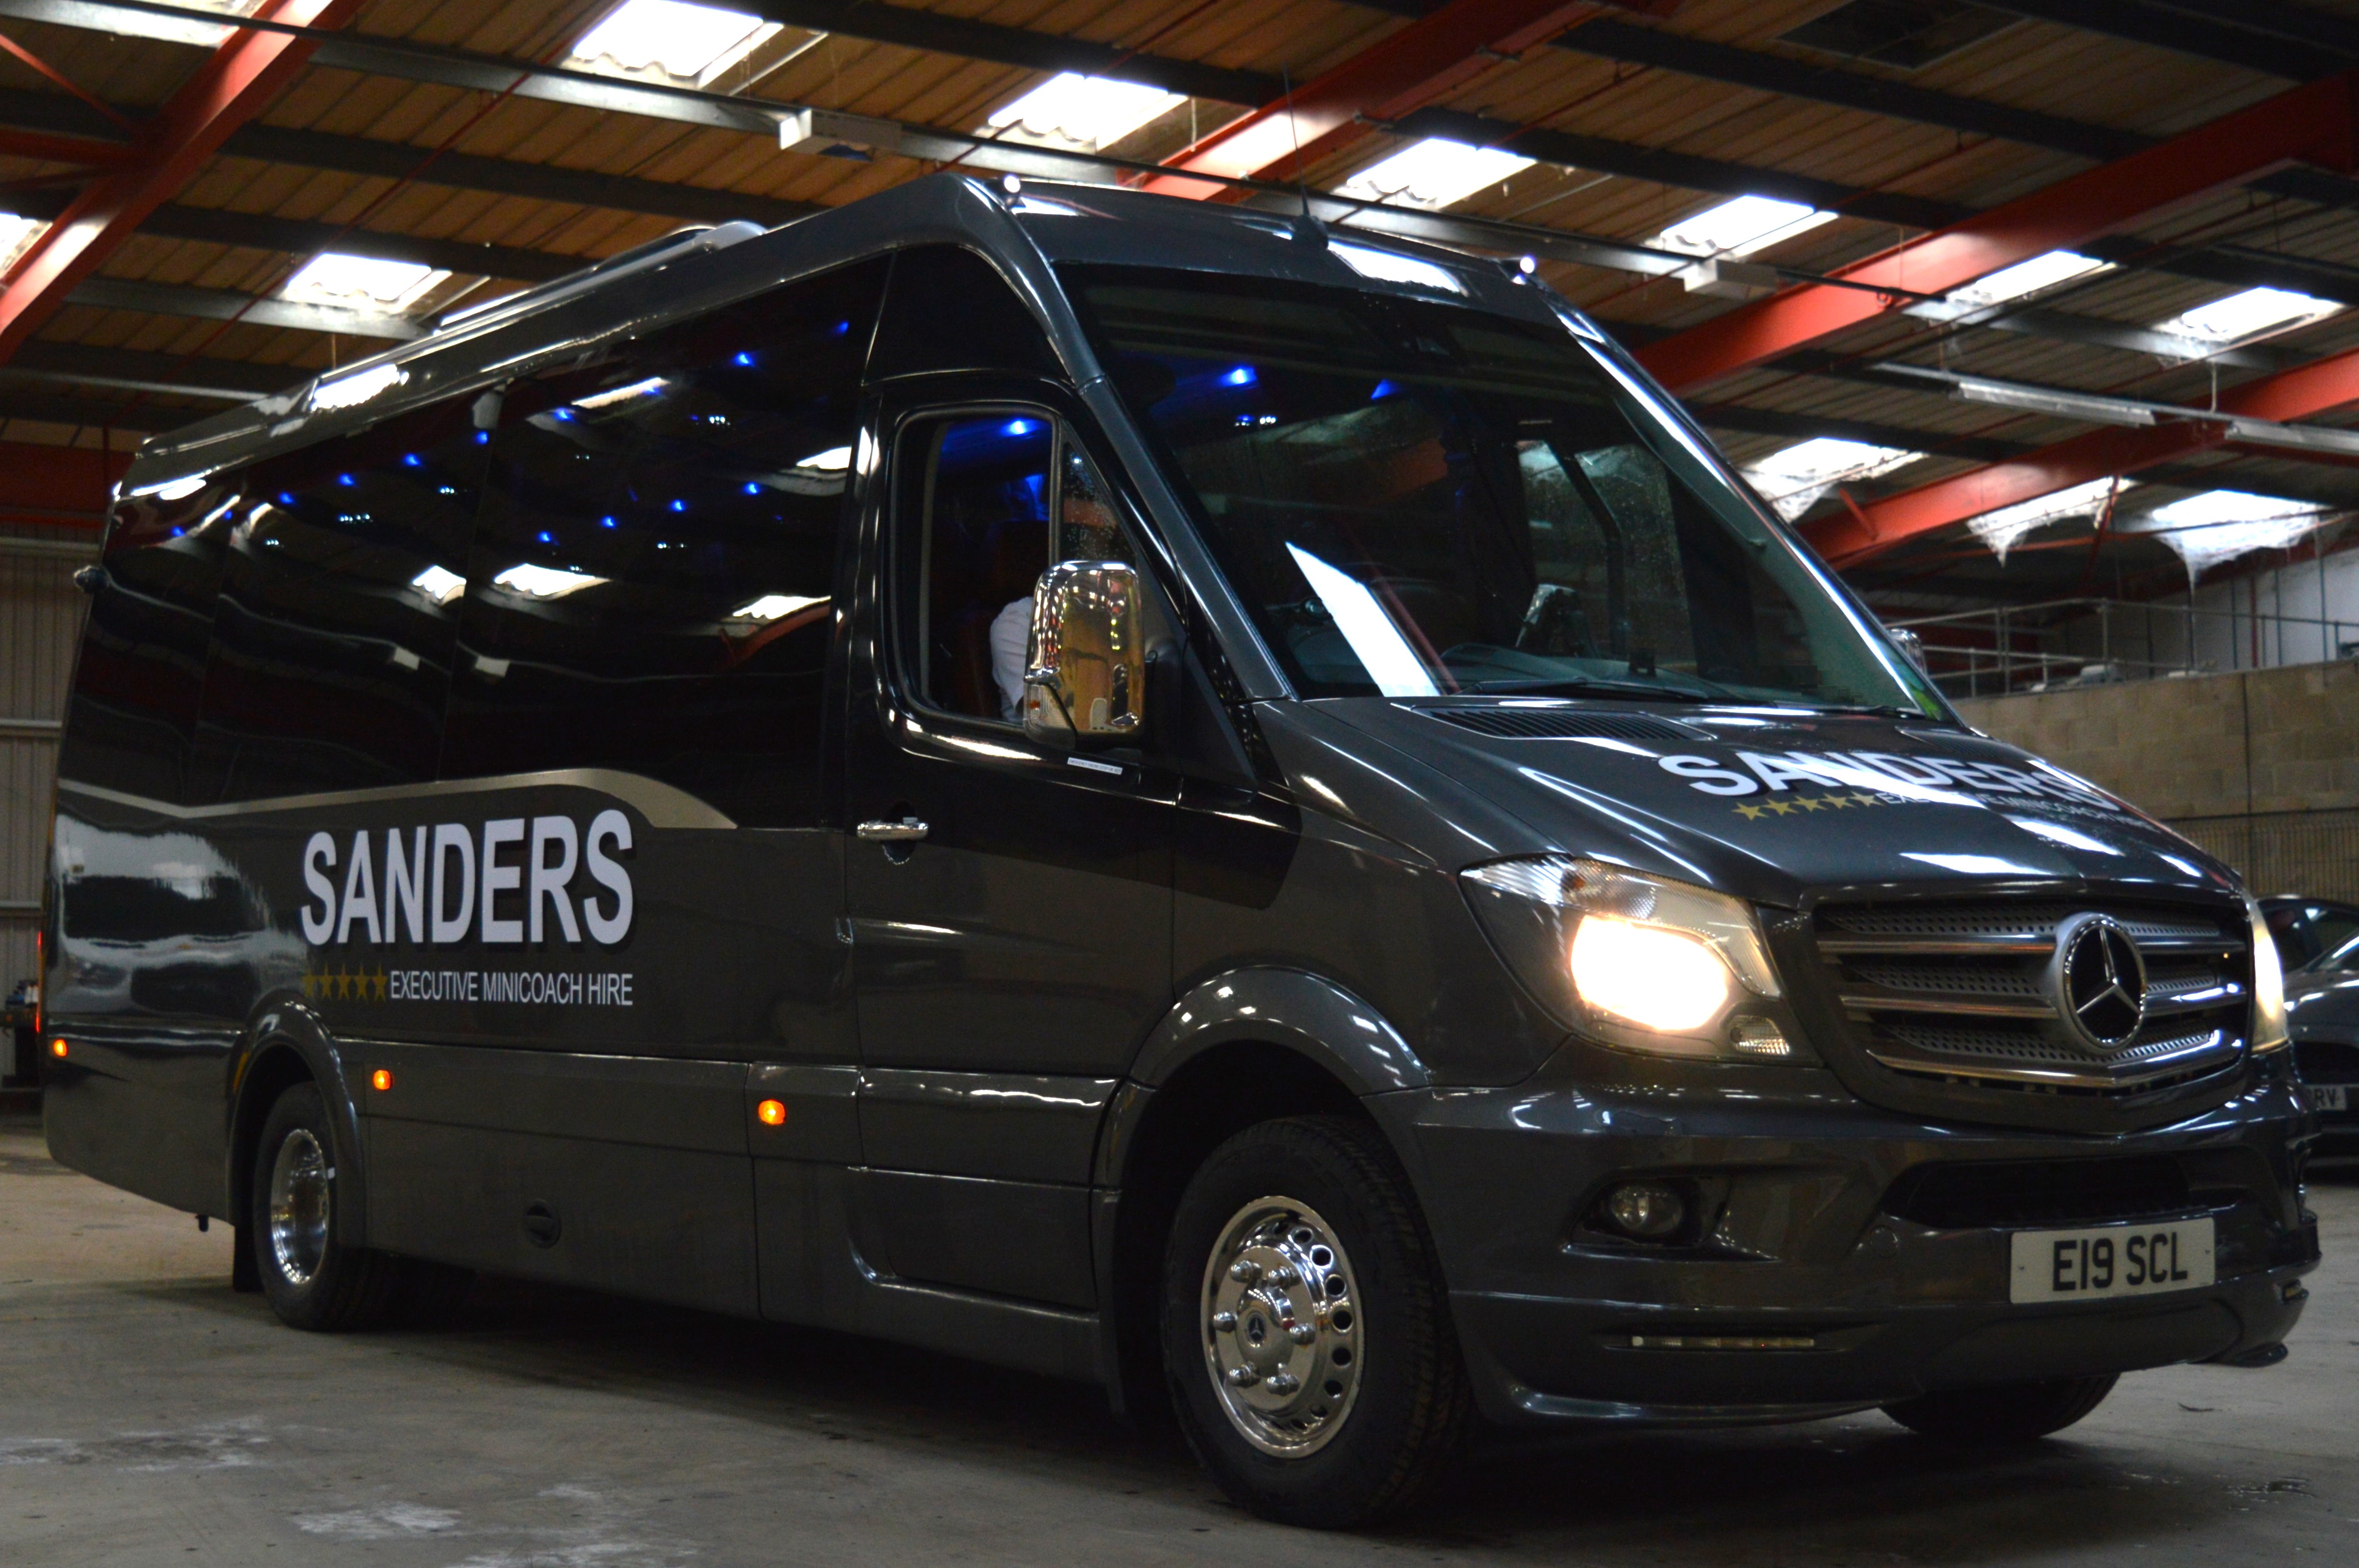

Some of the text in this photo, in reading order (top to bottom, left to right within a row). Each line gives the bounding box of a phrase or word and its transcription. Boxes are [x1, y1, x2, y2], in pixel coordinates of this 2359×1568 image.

[1658, 752, 2120, 811] SANDERS
[301, 809, 634, 945] SANDERS
[390, 970, 633, 1006] EXECUTIVE MINICOACH HIRE
[2053, 1232, 2188, 1292] E19 SCL
